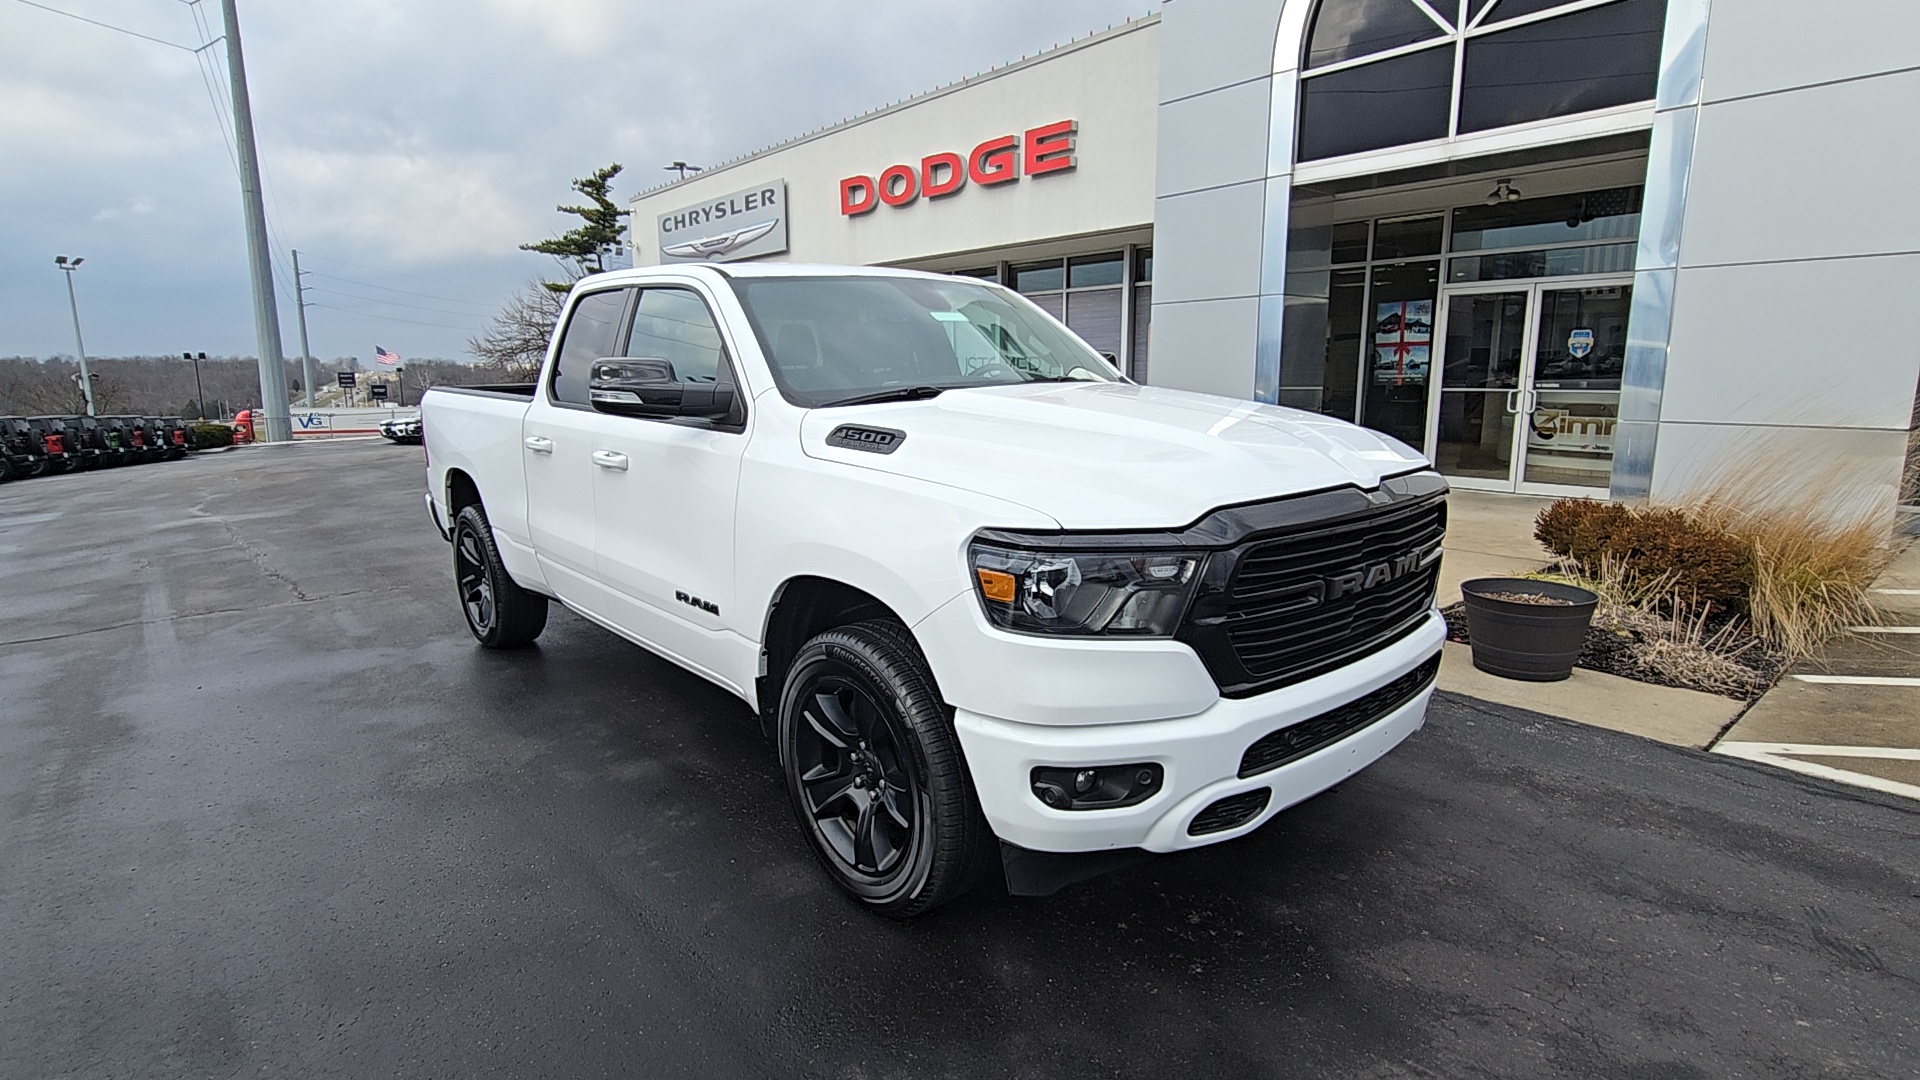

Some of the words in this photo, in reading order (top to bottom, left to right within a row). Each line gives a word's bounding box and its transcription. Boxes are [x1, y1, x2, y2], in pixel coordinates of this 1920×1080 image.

[839, 119, 1077, 216] DODGE
[662, 188, 776, 233] CHRYSLER
[834, 428, 893, 444] 1500
[1325, 549, 1420, 601] RAM
[675, 589, 720, 617] RAM
